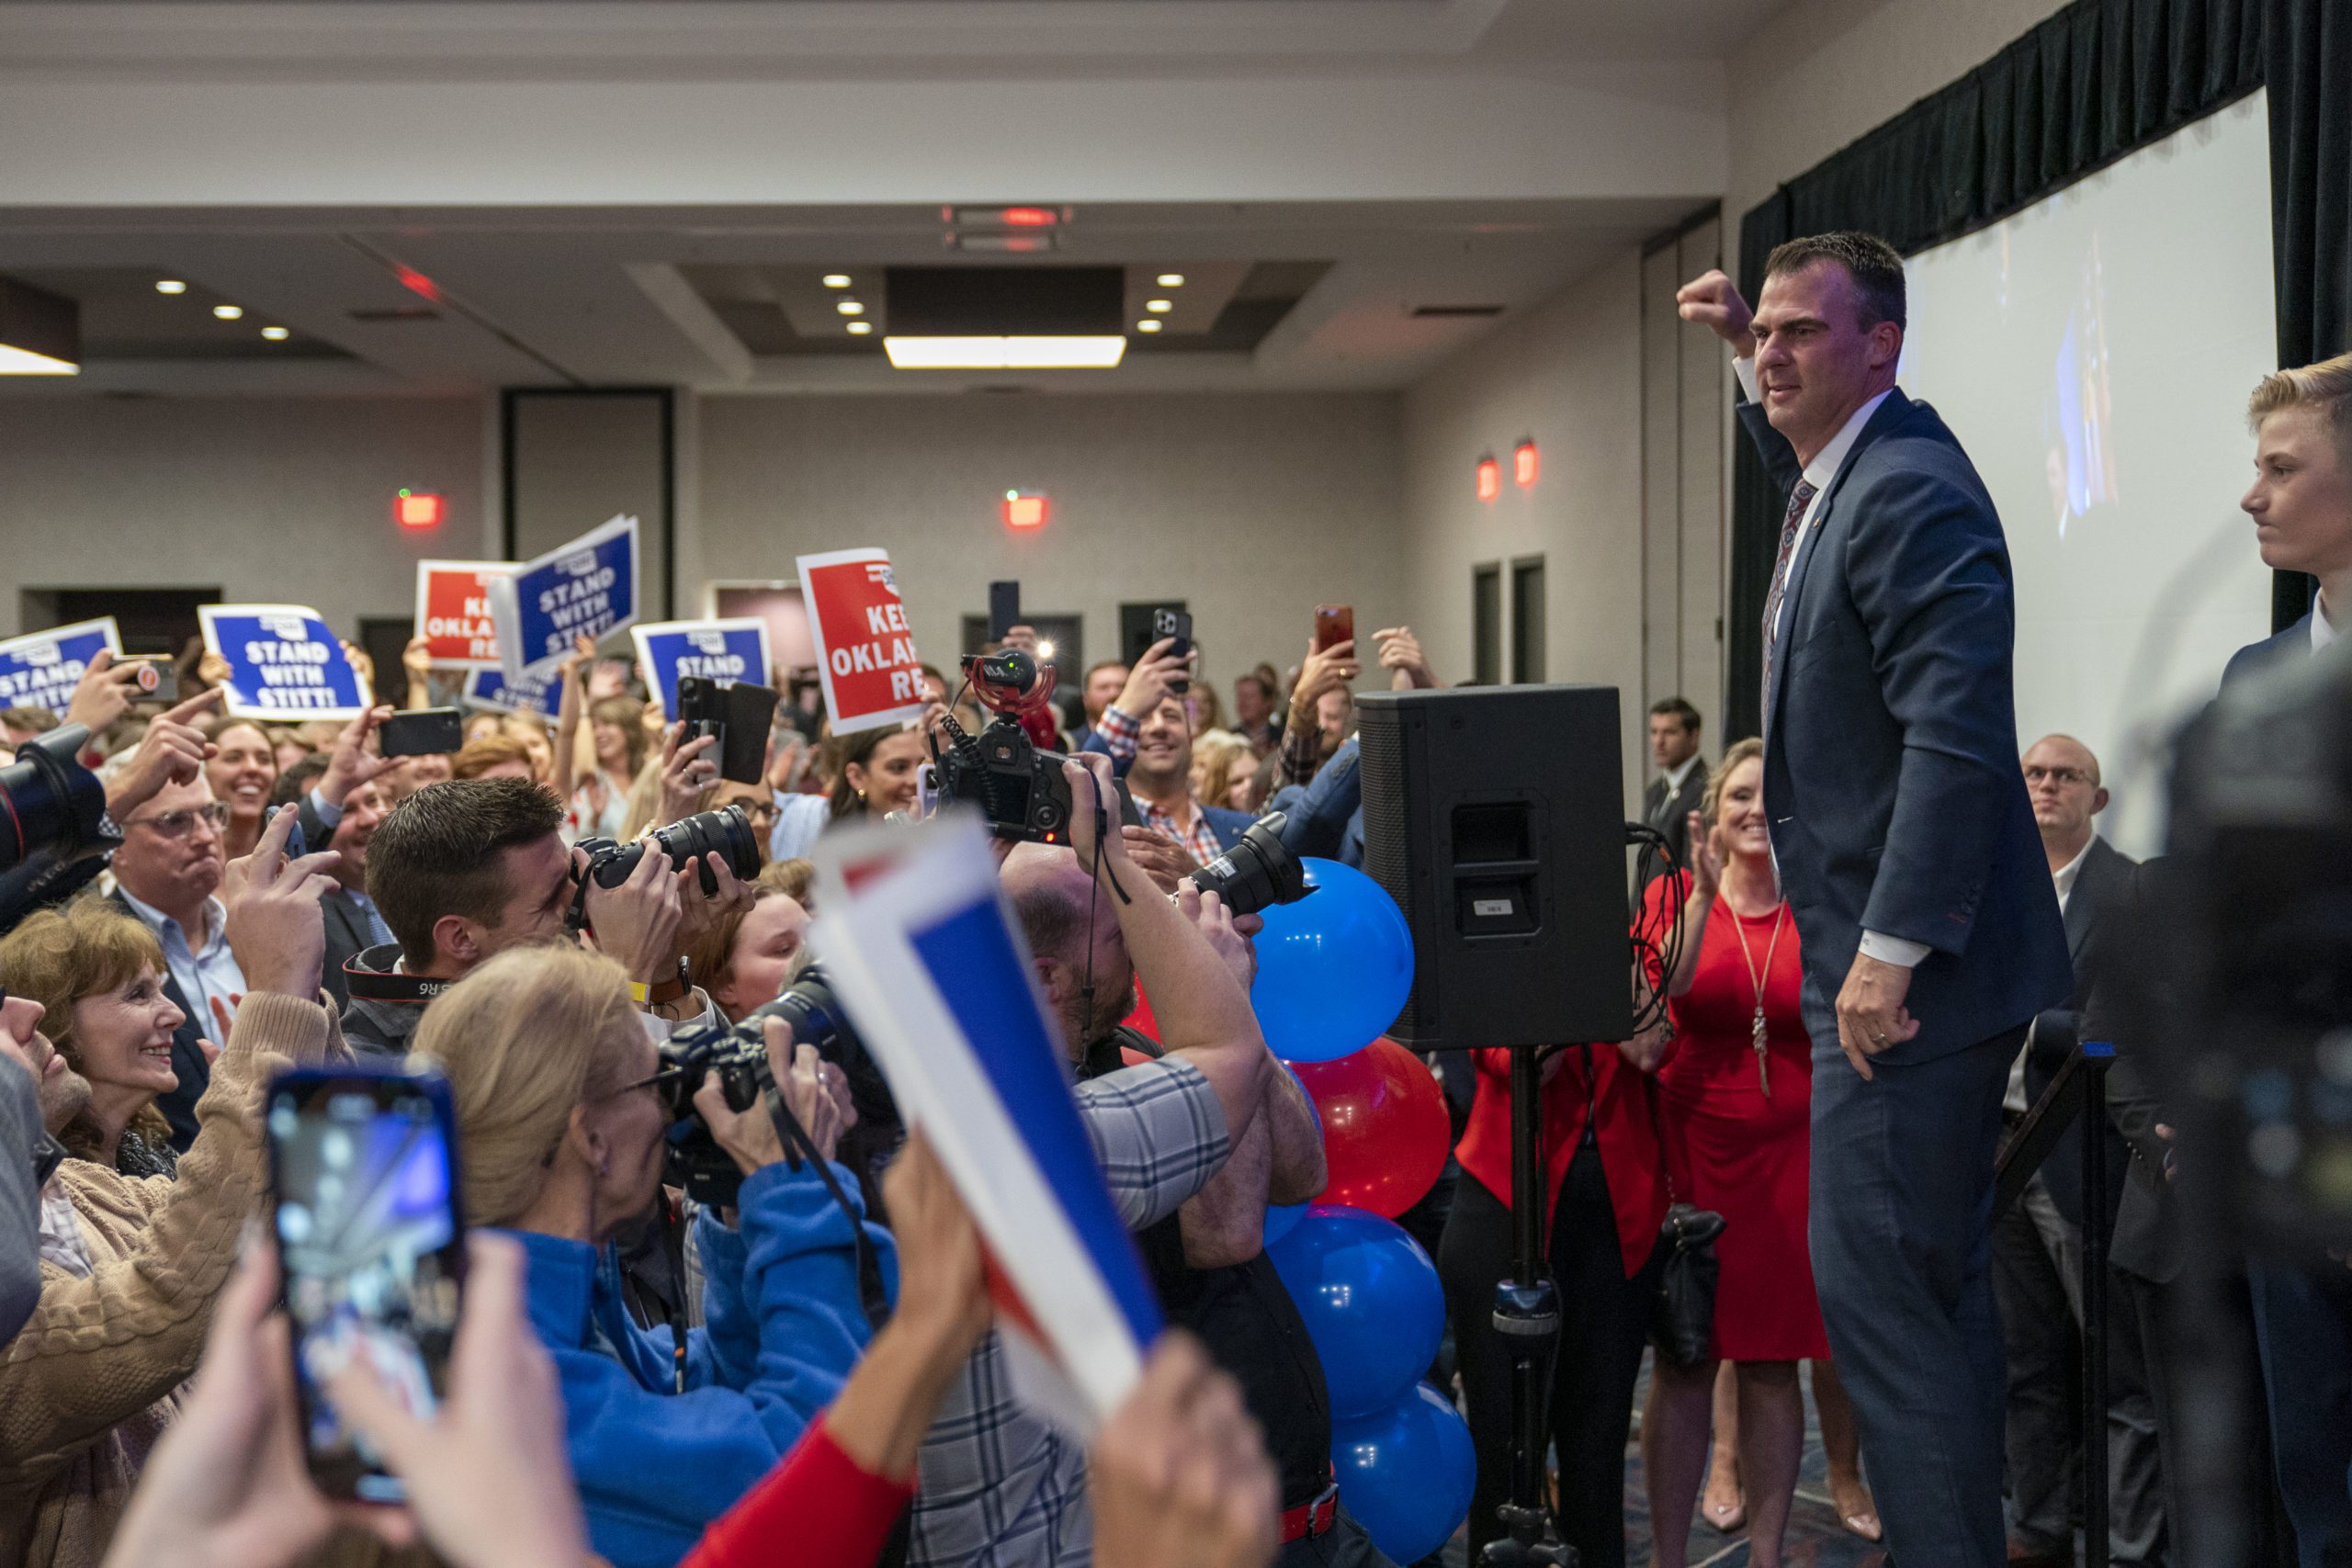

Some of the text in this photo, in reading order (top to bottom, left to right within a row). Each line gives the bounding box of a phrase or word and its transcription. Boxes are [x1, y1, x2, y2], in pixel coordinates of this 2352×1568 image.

[538, 566, 616, 614] STAND
[550, 589, 609, 630] WITH
[245, 640, 331, 665] STAND
[0, 659, 87, 697] STAND
[259, 664, 326, 687] WITH
[676, 654, 745, 678] STAND
[256, 686, 339, 707] STITT!
[419, 983, 438, 996] R6
